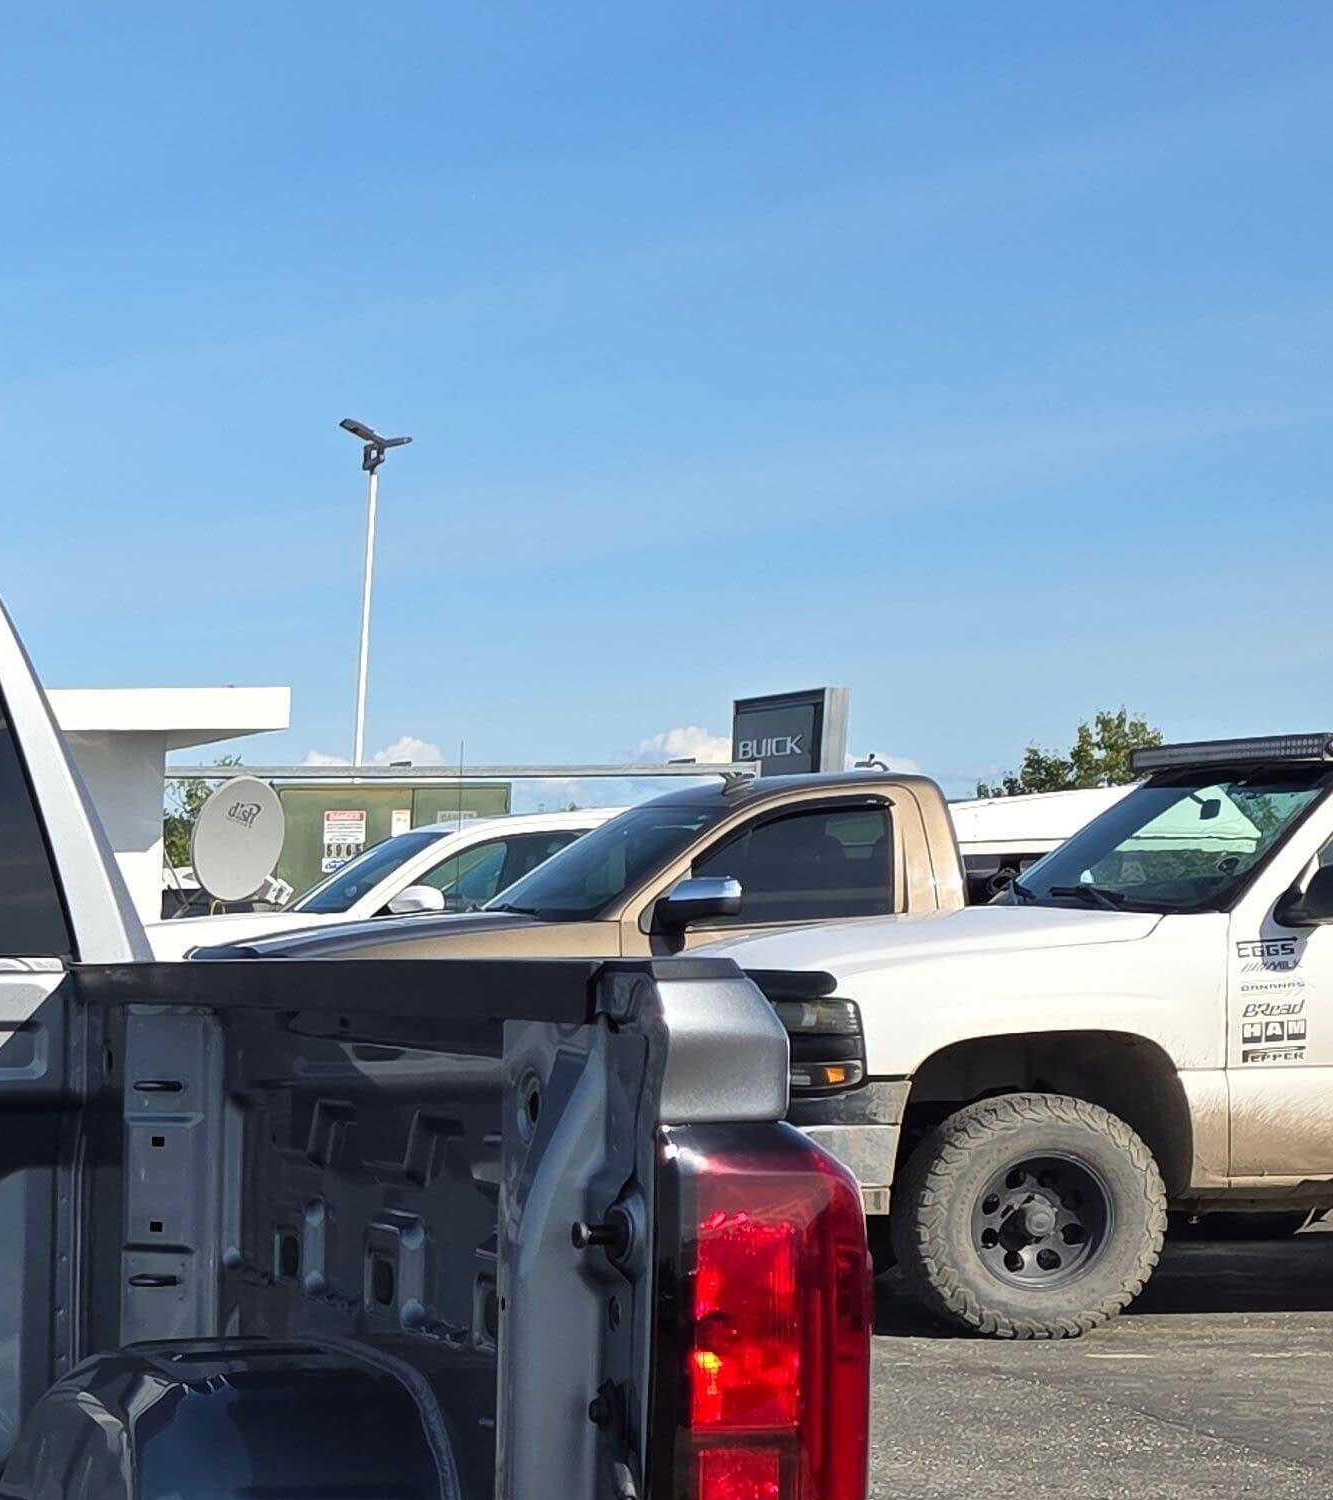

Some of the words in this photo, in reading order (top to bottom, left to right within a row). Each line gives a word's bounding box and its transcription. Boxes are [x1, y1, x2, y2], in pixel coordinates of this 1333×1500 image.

[738, 734, 802, 759] BUICK
[228, 802, 262, 825] dish
[1236, 938, 1297, 958] EGGS
[1242, 1019, 1306, 1043] HAM
